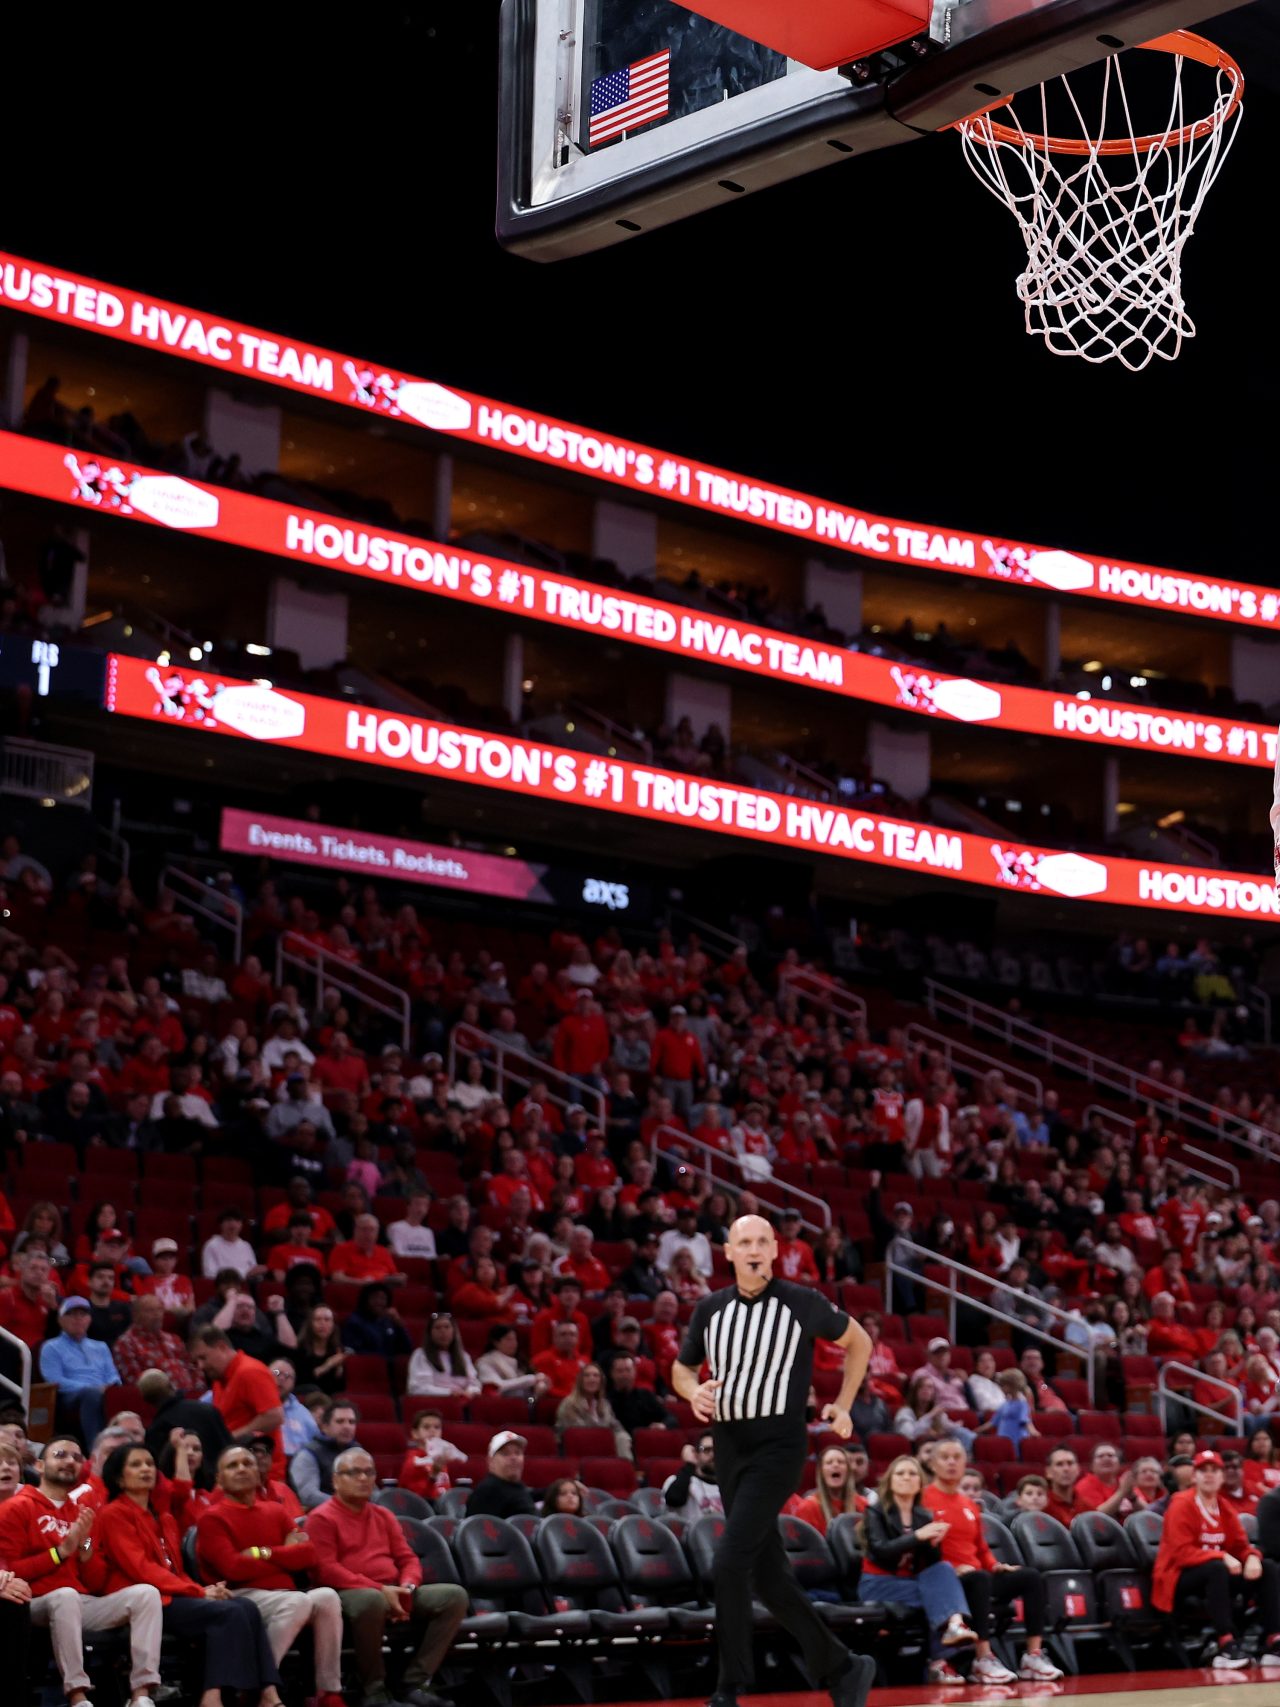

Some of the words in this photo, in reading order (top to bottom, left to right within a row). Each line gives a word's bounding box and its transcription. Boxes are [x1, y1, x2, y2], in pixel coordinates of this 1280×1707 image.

[130, 301, 232, 361] HVAC
[236, 332, 334, 392] TEAM
[477, 405, 655, 485] HOUSTON'S
[656, 459, 691, 497] #1
[694, 470, 814, 530] TRUSTED
[815, 506, 891, 553] HVAC
[892, 526, 976, 569] TEAM
[285, 514, 493, 598] HOUSTON'S
[496, 568, 536, 609] #1
[540, 579, 678, 643] TRUSTED
[680, 615, 762, 666] HVAC
[763, 637, 844, 687] TEAM
[1098, 564, 1258, 619] HOUSTON'S
[1053, 700, 1224, 754] HOUSTON'S
[1226, 726, 1259, 759] #1
[345, 710, 577, 793] HOUSTON'S
[581, 759, 625, 803] #1
[631, 769, 782, 833] TRUSTED
[785, 803, 876, 853] HVAC
[877, 824, 964, 871] TEAM
[247, 823, 318, 855] Events.
[321, 835, 392, 868] Tickets.
[393, 848, 469, 881] Rockets.
